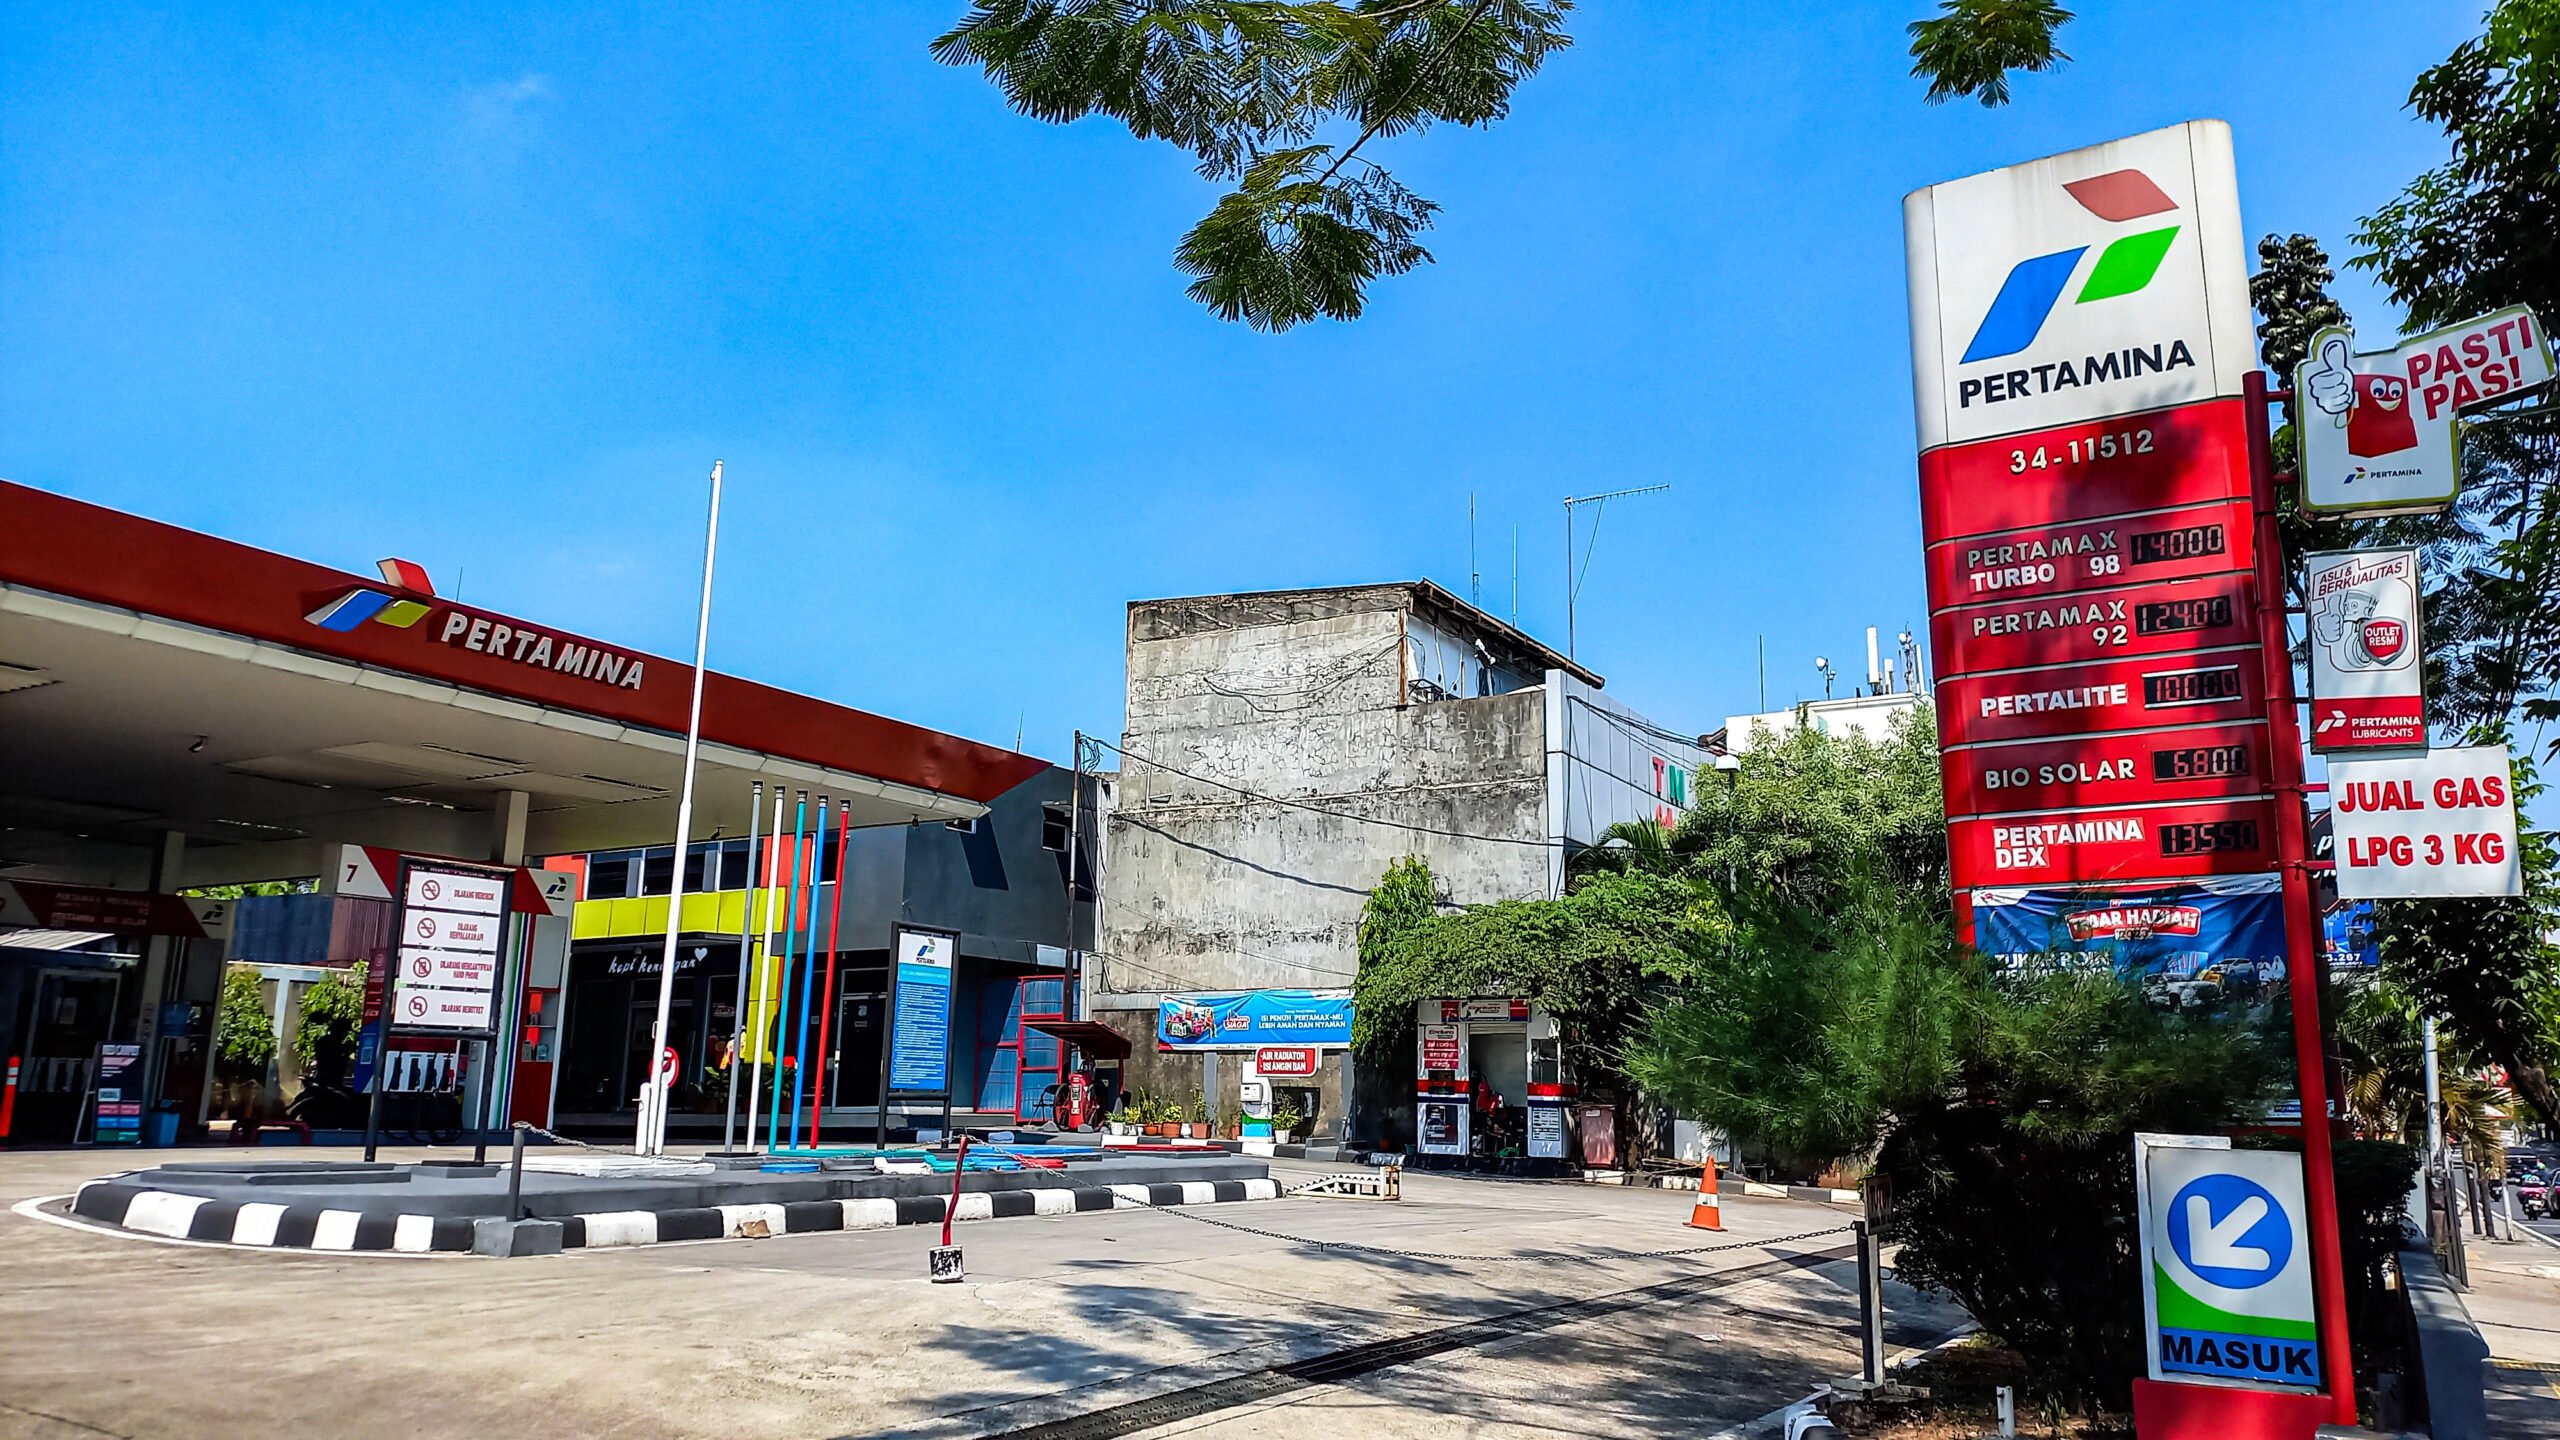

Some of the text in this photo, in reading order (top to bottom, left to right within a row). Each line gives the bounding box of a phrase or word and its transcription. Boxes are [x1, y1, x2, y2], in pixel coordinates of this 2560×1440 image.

[2406, 315, 2534, 390] PASTI
[1958, 338, 2197, 409] PERTAMINA
[2423, 356, 2523, 421] PAS!
[2010, 428, 2155, 475] 34-11512
[2370, 468, 2422, 479] PERTAMINA
[1967, 529, 2118, 569] PERTAMAX
[2135, 525, 2224, 562] 14000
[1970, 553, 2121, 593] TURBO 98
[2319, 565, 2352, 585] ASLI &
[2319, 561, 2403, 597] BERKUALITAS
[1973, 599, 2128, 638] PERTAMAX
[2141, 598, 2229, 632] 12400
[2365, 625, 2401, 637] OUTLET
[440, 611, 645, 691] PERTAMINA
[2092, 624, 2129, 648] 92
[2369, 636, 2398, 647] RESMI
[1981, 683, 2128, 718] PERTALITE
[2156, 670, 2239, 702] 10000
[2351, 716, 2422, 727] PERTAMINA
[2352, 728, 2414, 739] LUBRICANTS
[1985, 758, 2136, 790] BIO SOLAR
[2173, 747, 2245, 776] 6800
[2338, 776, 2505, 813] JUAL GAS
[1994, 819, 2143, 849] PERTAMINA
[2348, 835, 2414, 867] LPG
[2423, 835, 2444, 866] 3
[2454, 833, 2505, 865] KG
[346, 864, 359, 882] 7
[1995, 845, 2047, 869] DEX
[2162, 1334, 2315, 1377] MASUK
